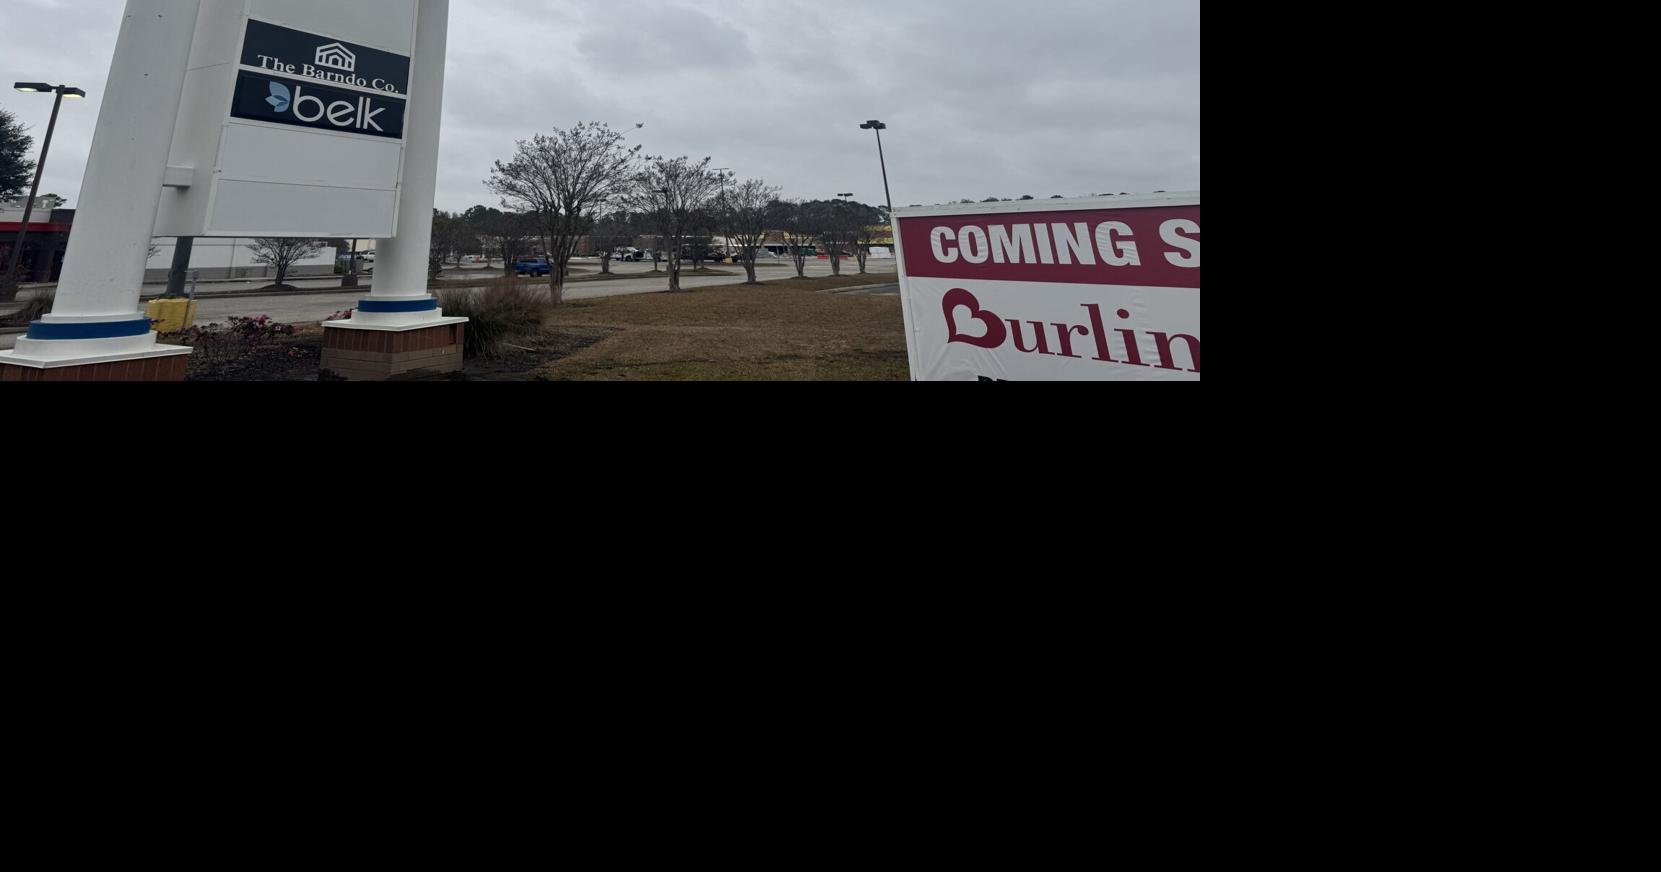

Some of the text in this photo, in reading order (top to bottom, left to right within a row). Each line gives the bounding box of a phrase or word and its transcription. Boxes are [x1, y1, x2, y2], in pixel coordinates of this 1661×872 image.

[257, 54, 399, 94] The Barndo Co.
[292, 86, 386, 132] belk
[930, 220, 1142, 267] COMING
